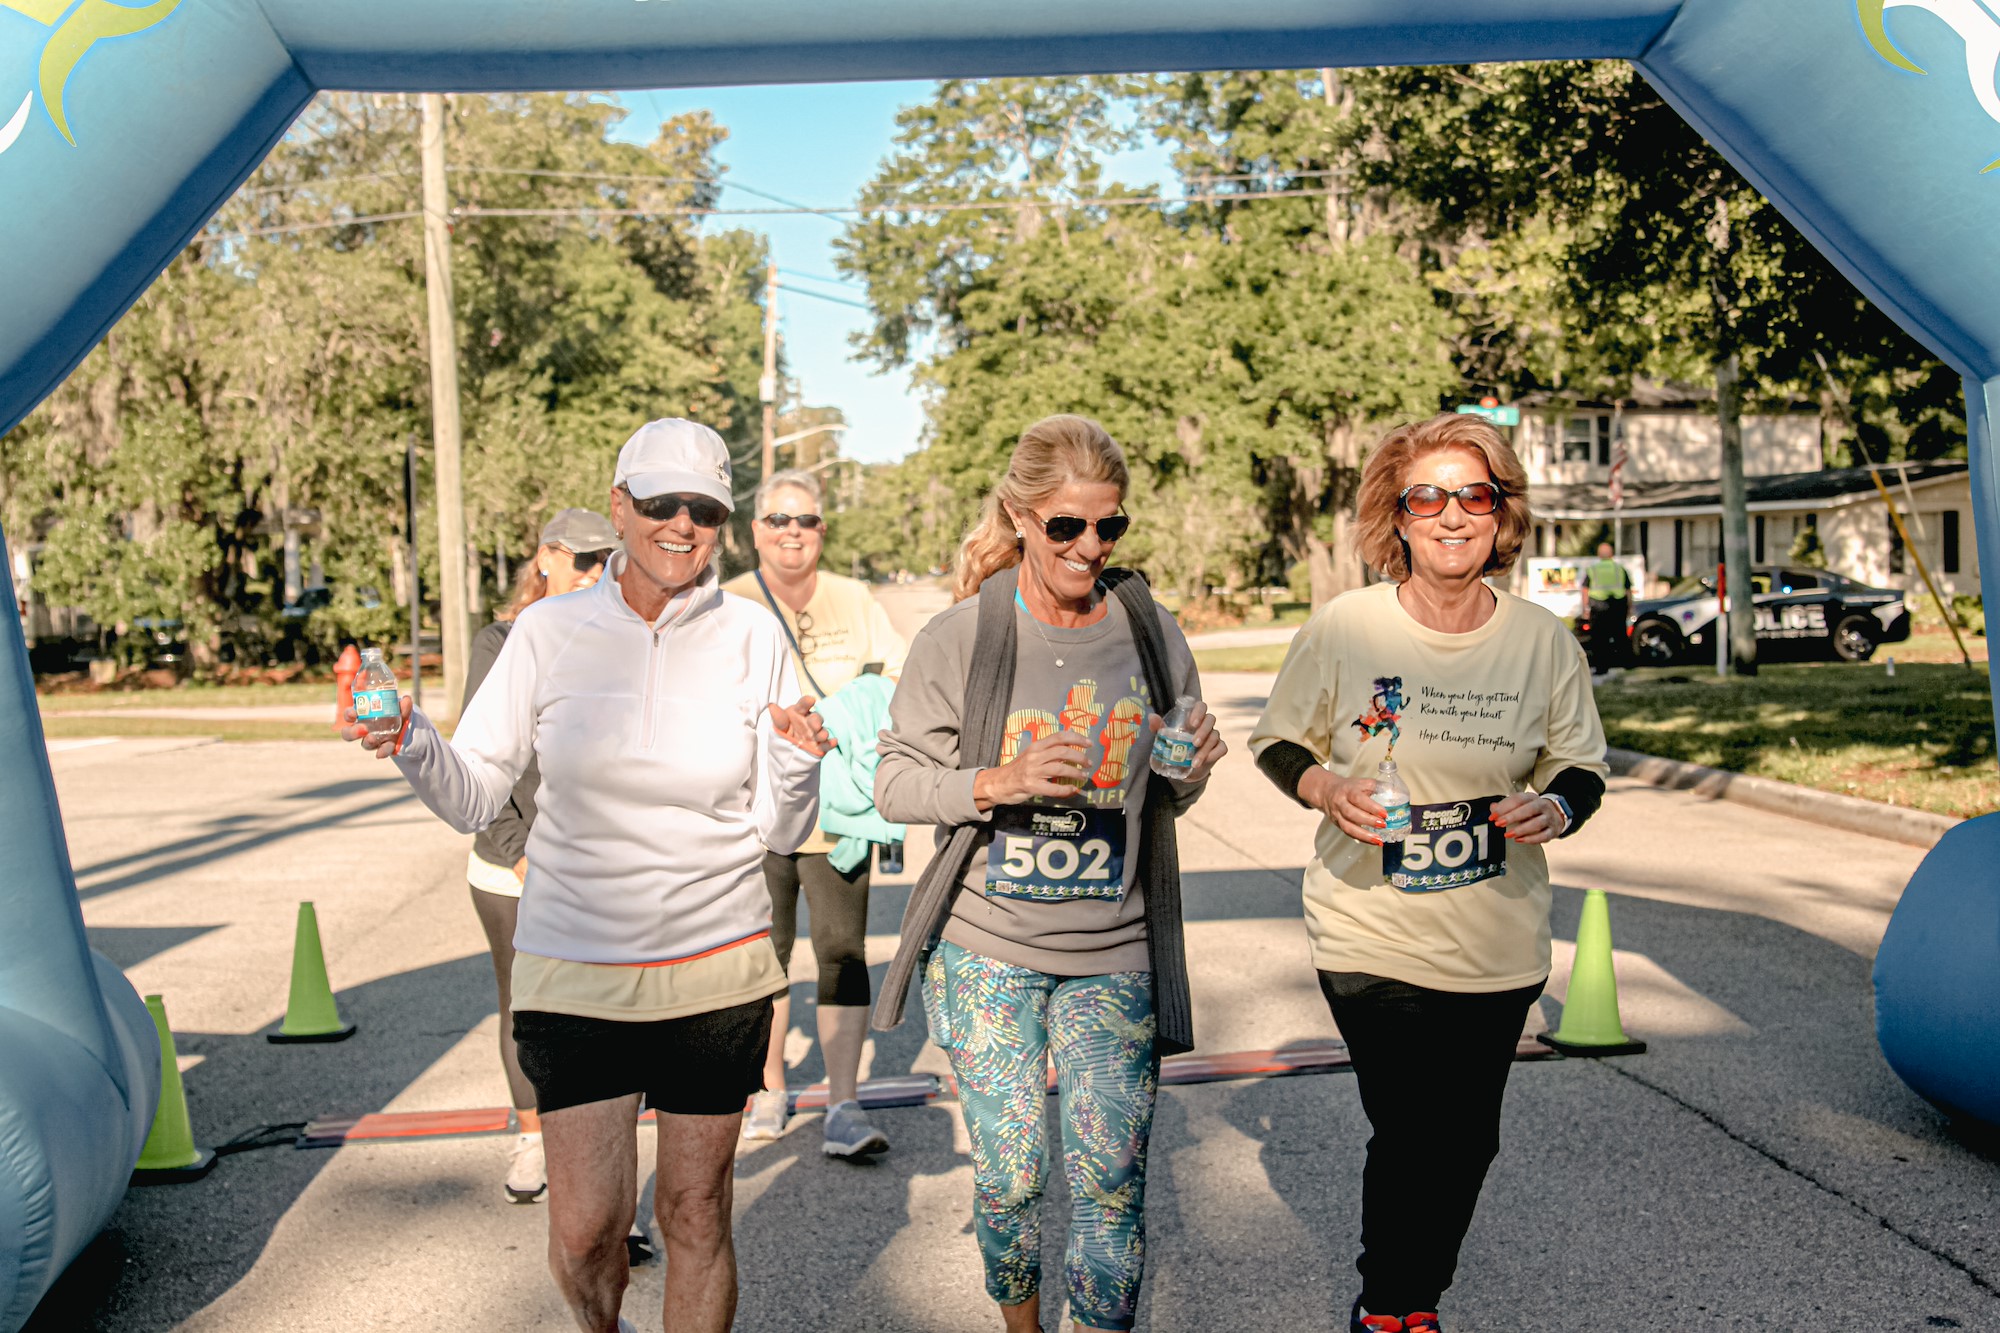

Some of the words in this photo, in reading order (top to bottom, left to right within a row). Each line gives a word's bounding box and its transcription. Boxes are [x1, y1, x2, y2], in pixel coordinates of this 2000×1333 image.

[1752, 604, 1826, 631] OLICE
[1421, 686, 1446, 699] When
[1448, 693, 1465, 704] your
[1467, 690, 1484, 706] legs
[1486, 692, 1498, 706] get
[1497, 691, 1519, 703] tired
[1420, 703, 1437, 715] Run
[1439, 706, 1458, 716] with
[1460, 710, 1477, 722] your
[1480, 707, 1505, 719] heart
[1419, 729, 1439, 744] Hope
[1441, 730, 1475, 749] Changes
[1477, 734, 1515, 754] Everything
[1032, 813, 1072, 824] Second
[1422, 807, 1460, 819] Second
[1440, 814, 1463, 826] Wind
[1001, 836, 1110, 879] 502
[1401, 824, 1488, 871] 501
